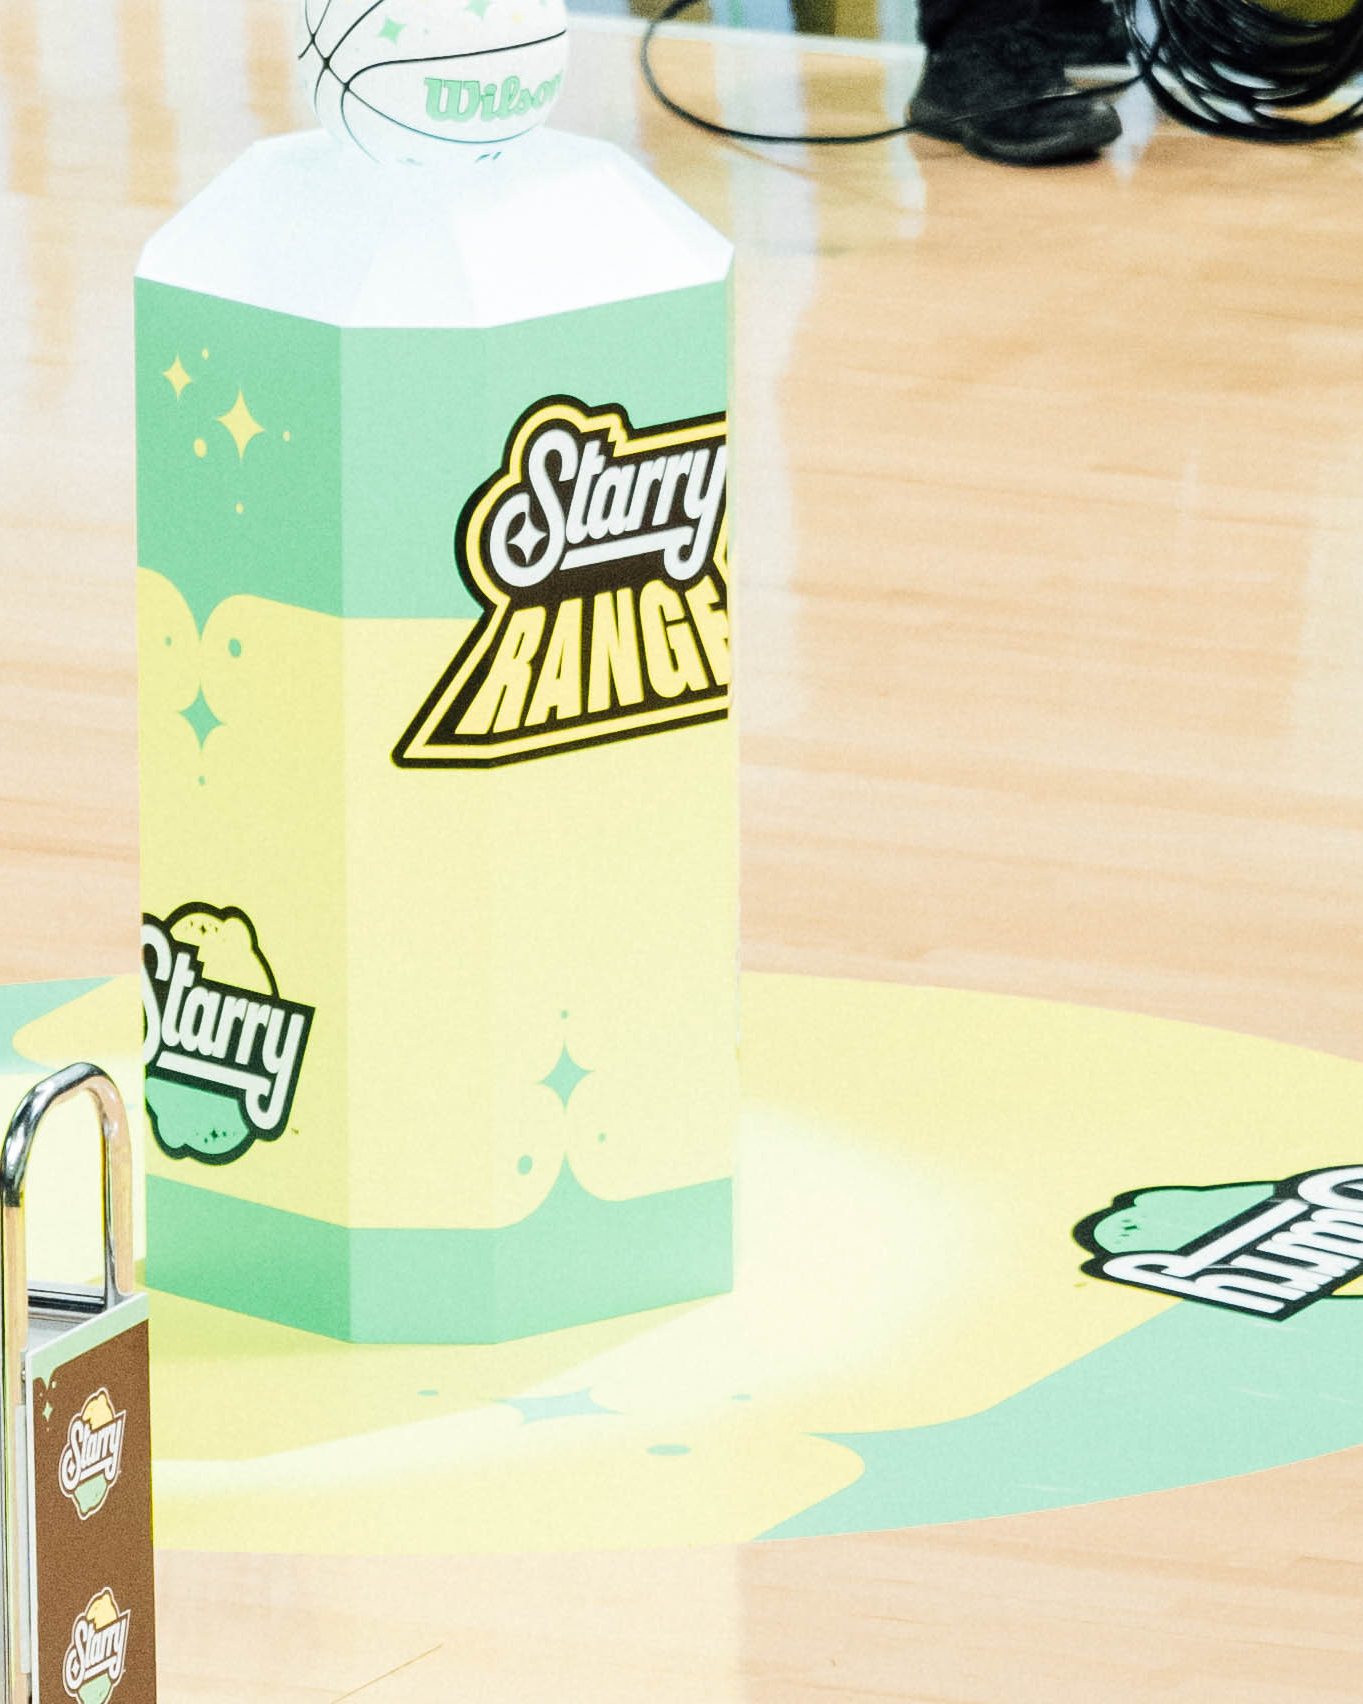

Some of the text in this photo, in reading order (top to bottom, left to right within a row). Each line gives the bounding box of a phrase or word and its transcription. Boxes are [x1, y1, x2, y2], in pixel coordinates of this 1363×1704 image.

[488, 427, 727, 588] Starry
[61, 1420, 122, 1491] Starry
[65, 1618, 126, 1690] Starry
